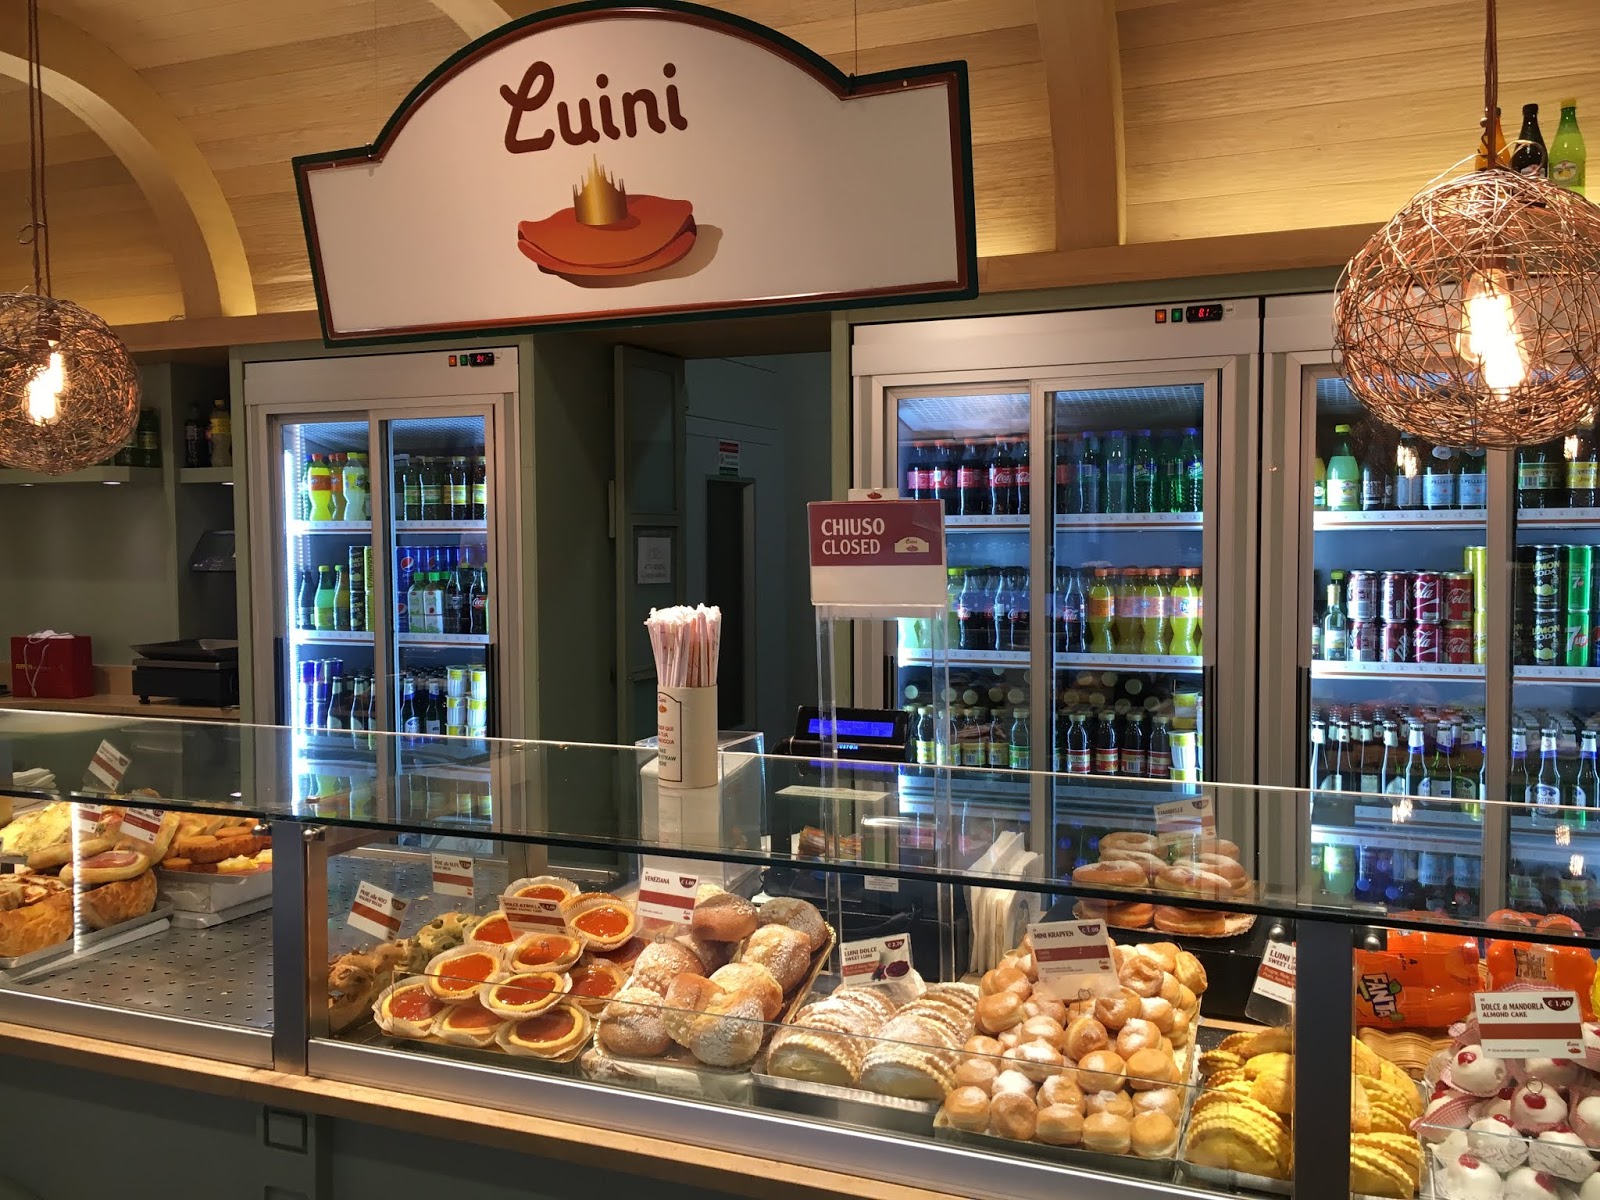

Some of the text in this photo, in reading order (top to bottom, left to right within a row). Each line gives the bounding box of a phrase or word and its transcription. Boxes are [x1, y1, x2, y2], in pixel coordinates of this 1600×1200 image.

[500, 60, 688, 154] Luini
[821, 517, 885, 536] CHIUSO
[821, 539, 881, 555] CLOSED
[1532, 560, 1560, 572] LEMON
[1533, 569, 1557, 577] SODA
[1532, 624, 1560, 635] LEMON
[1533, 633, 1557, 641] SODA
[645, 875, 670, 885] VENEZIANA
[1048, 930, 1074, 938] KRAPFEN
[844, 946, 877, 957] LUINI DOLCE
[1270, 950, 1290, 962] LUINI
[1268, 957, 1288, 968] SWEET
[1481, 1003, 1501, 1011] DOLCE
[1508, 1002, 1544, 1011] MANDORLA
